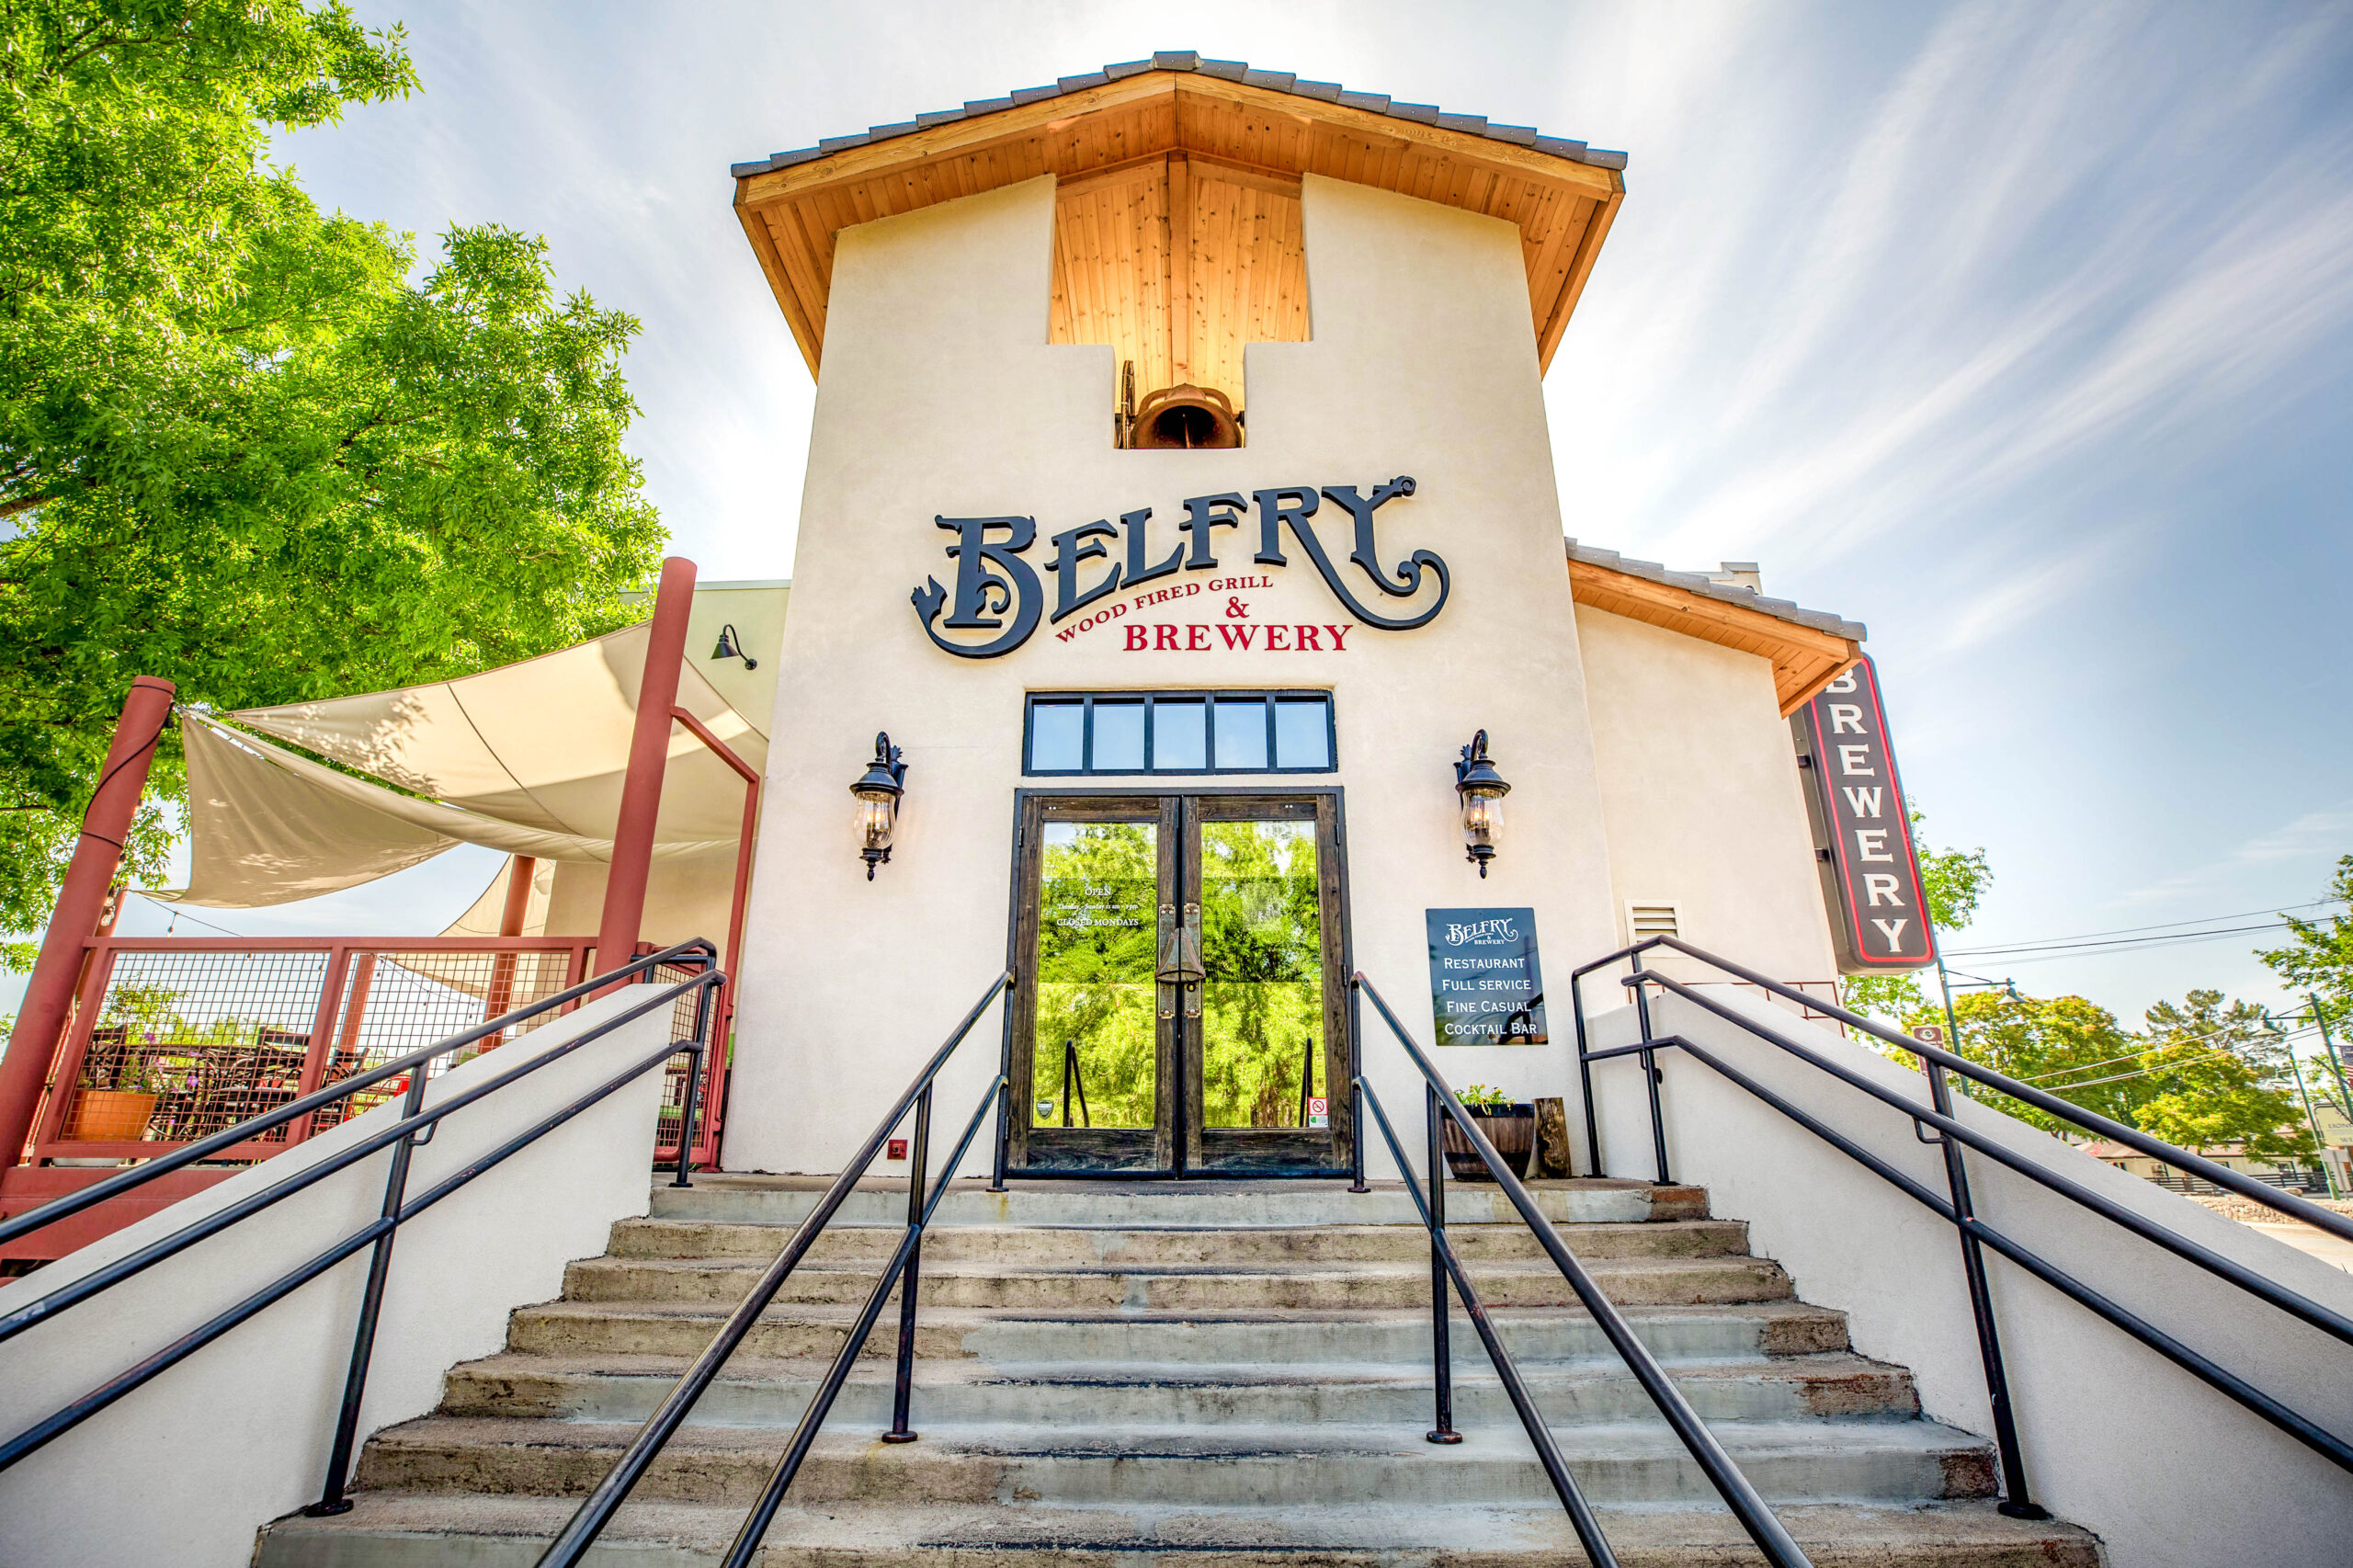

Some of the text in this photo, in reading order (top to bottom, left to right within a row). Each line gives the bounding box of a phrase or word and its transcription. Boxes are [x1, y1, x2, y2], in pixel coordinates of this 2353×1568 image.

[911, 475, 1450, 659] BELFRY
[1055, 575, 1274, 642] WOOD FIRED GRILL
[1224, 596, 1250, 619] &
[1122, 624, 1354, 652] BREWERY
[1085, 888, 1112, 896] OPEN
[1056, 918, 1139, 926] CLOSED MONDAYS
[1445, 917, 1519, 947] BELFRY
[1444, 958, 1526, 970] RESTAURANT
[1442, 979, 1531, 991] FULL SERVICE
[1447, 1000, 1532, 1013] FINE CASUAL
[1444, 1022, 1538, 1036] COCKTAIL BAR
